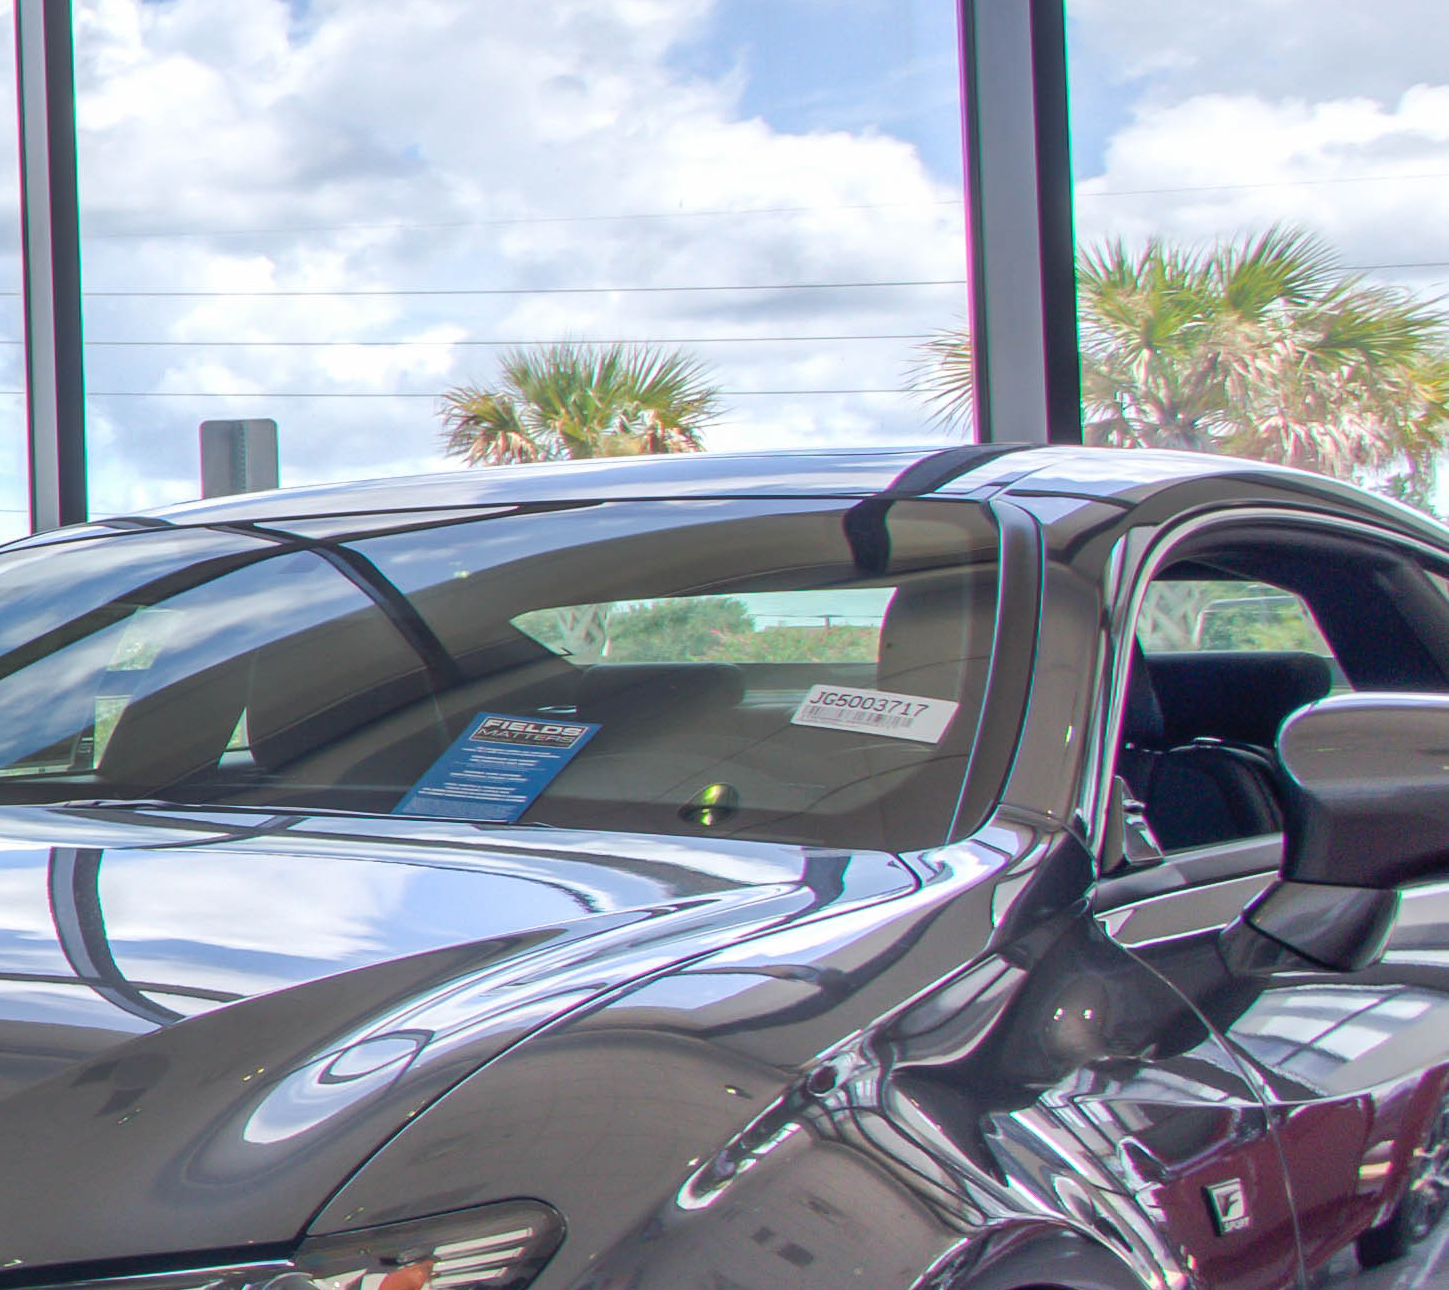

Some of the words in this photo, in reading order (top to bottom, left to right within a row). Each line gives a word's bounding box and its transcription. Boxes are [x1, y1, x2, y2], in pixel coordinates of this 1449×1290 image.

[809, 691, 930, 718] JG5003717
[477, 728, 576, 744] MATTERS
[483, 718, 584, 737] FIELDS
